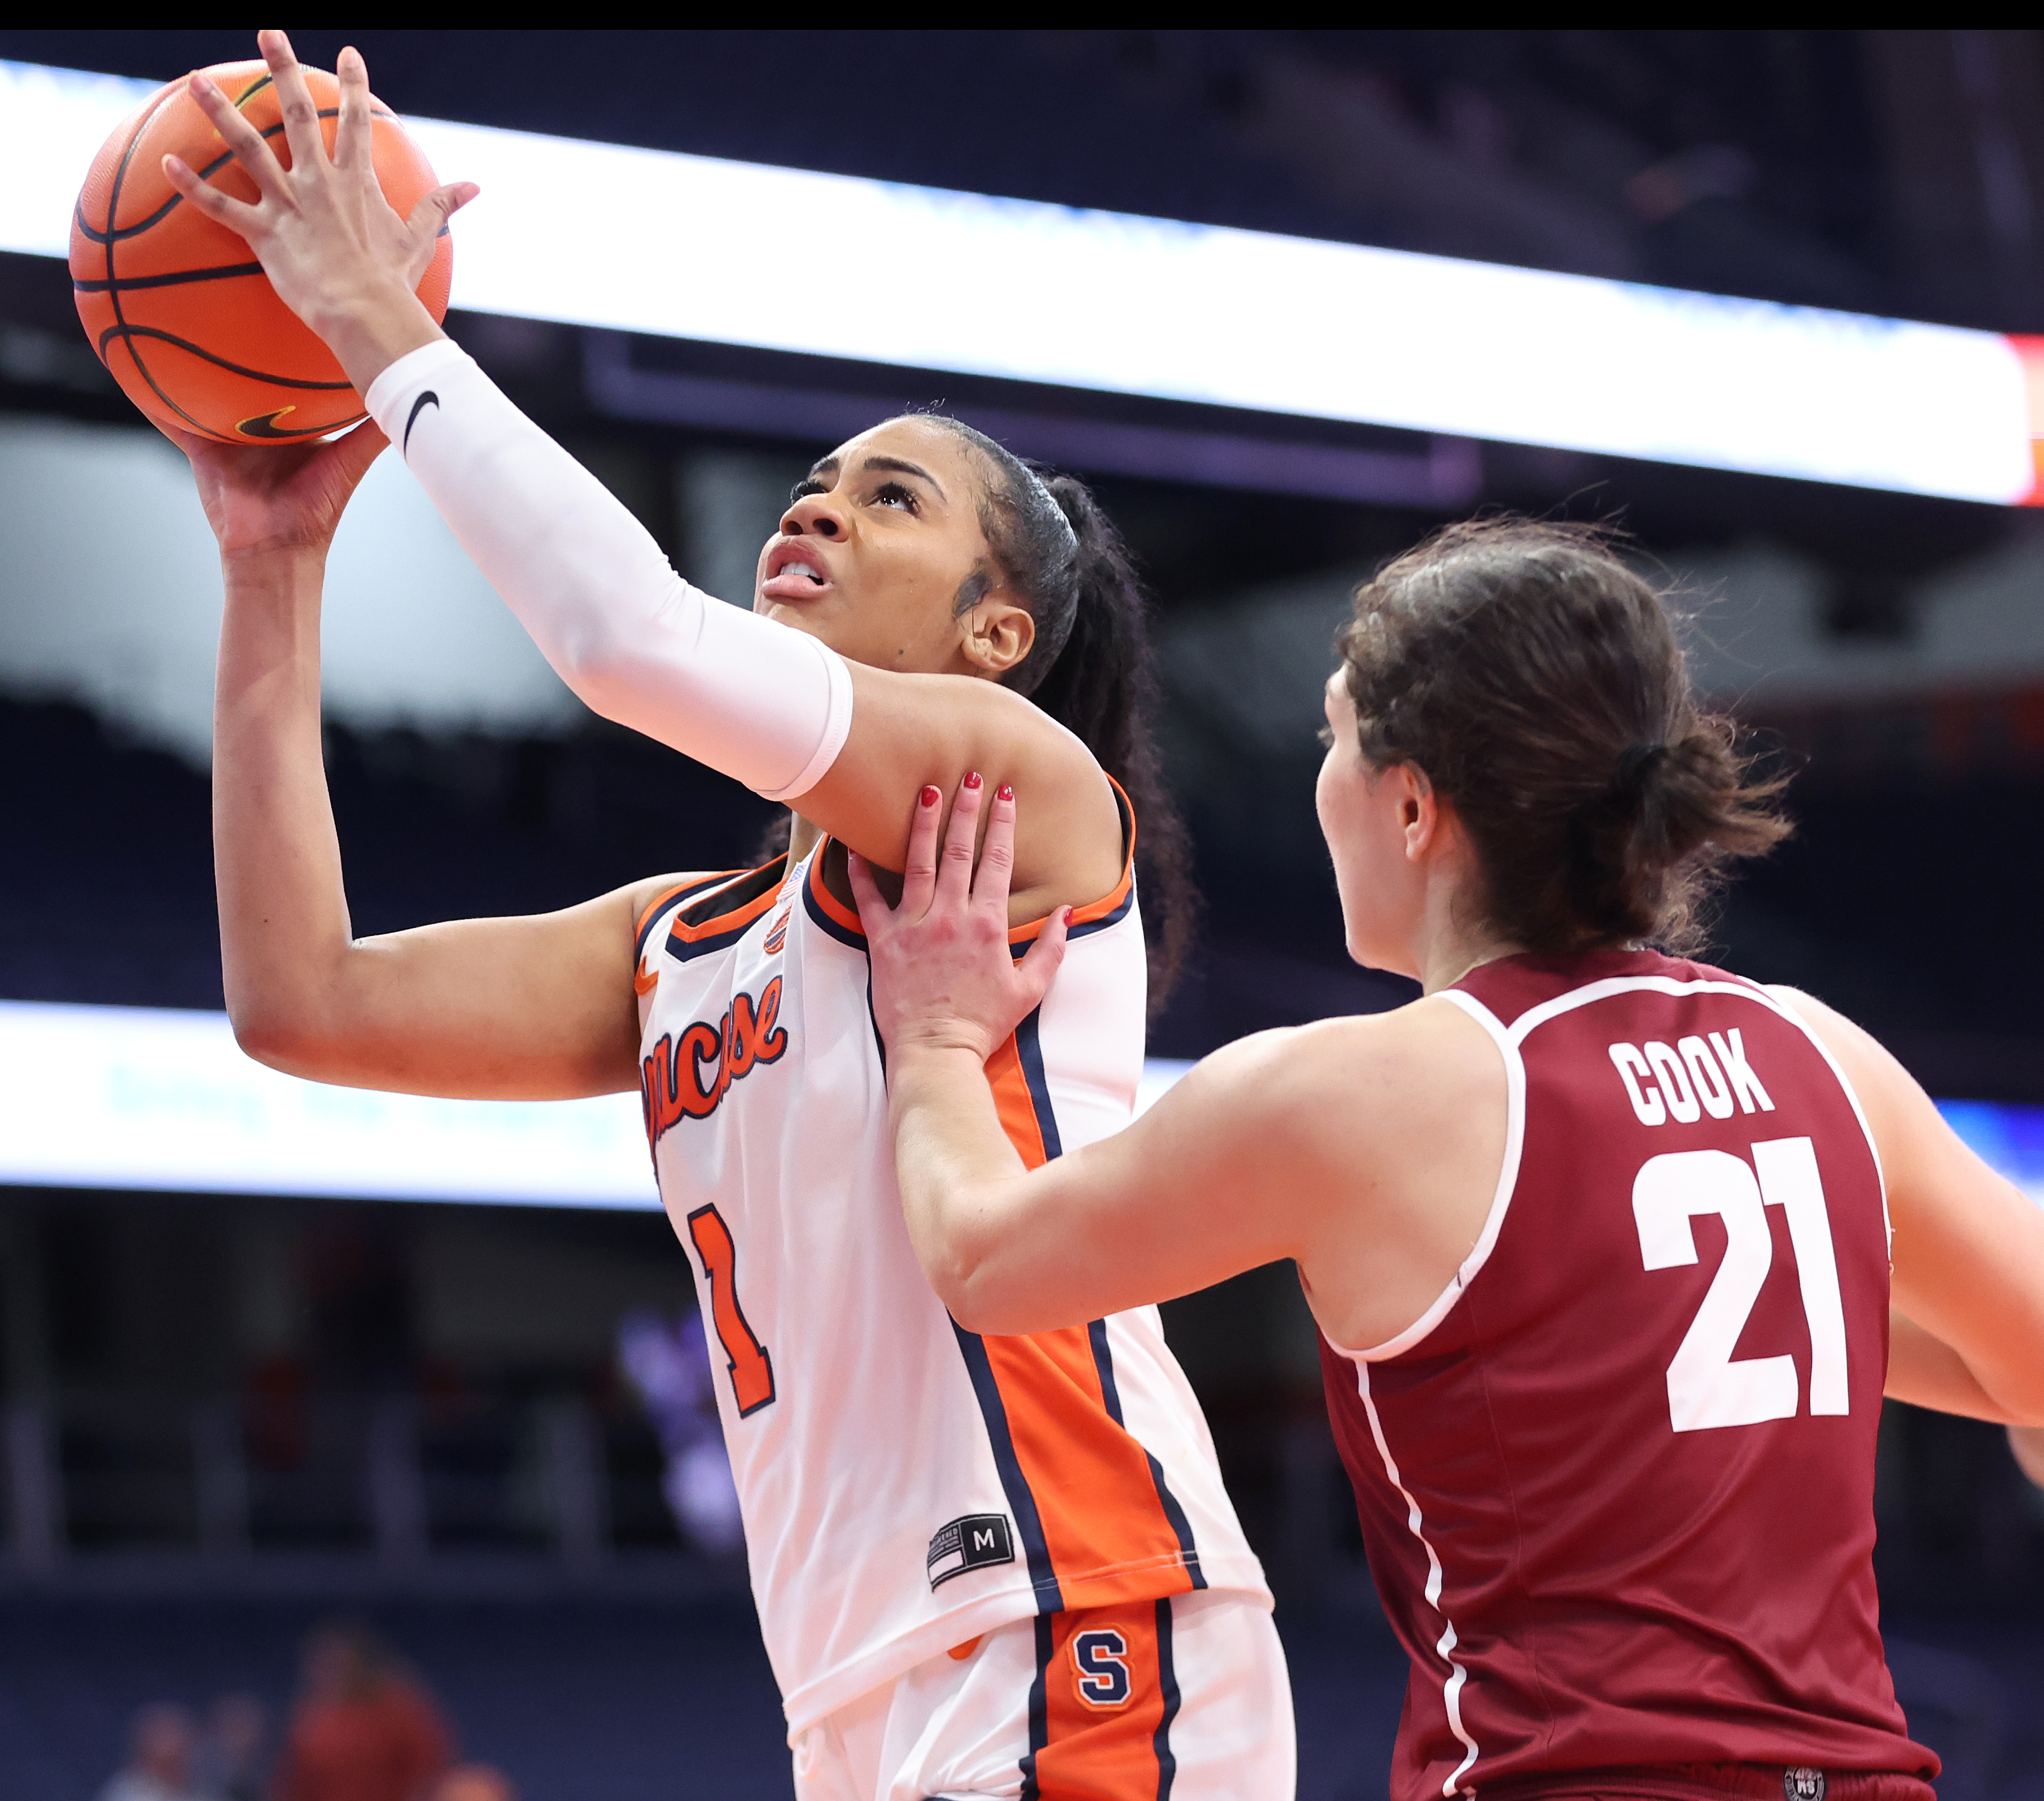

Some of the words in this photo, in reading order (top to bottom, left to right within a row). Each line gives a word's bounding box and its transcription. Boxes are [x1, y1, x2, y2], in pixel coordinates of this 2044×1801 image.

[1608, 1028, 1775, 1126] COOK
[687, 1203, 776, 1419] 1
[1632, 1136, 1849, 1432] 21
[973, 1528, 995, 1551] M
[1073, 1629, 1131, 1704] S
